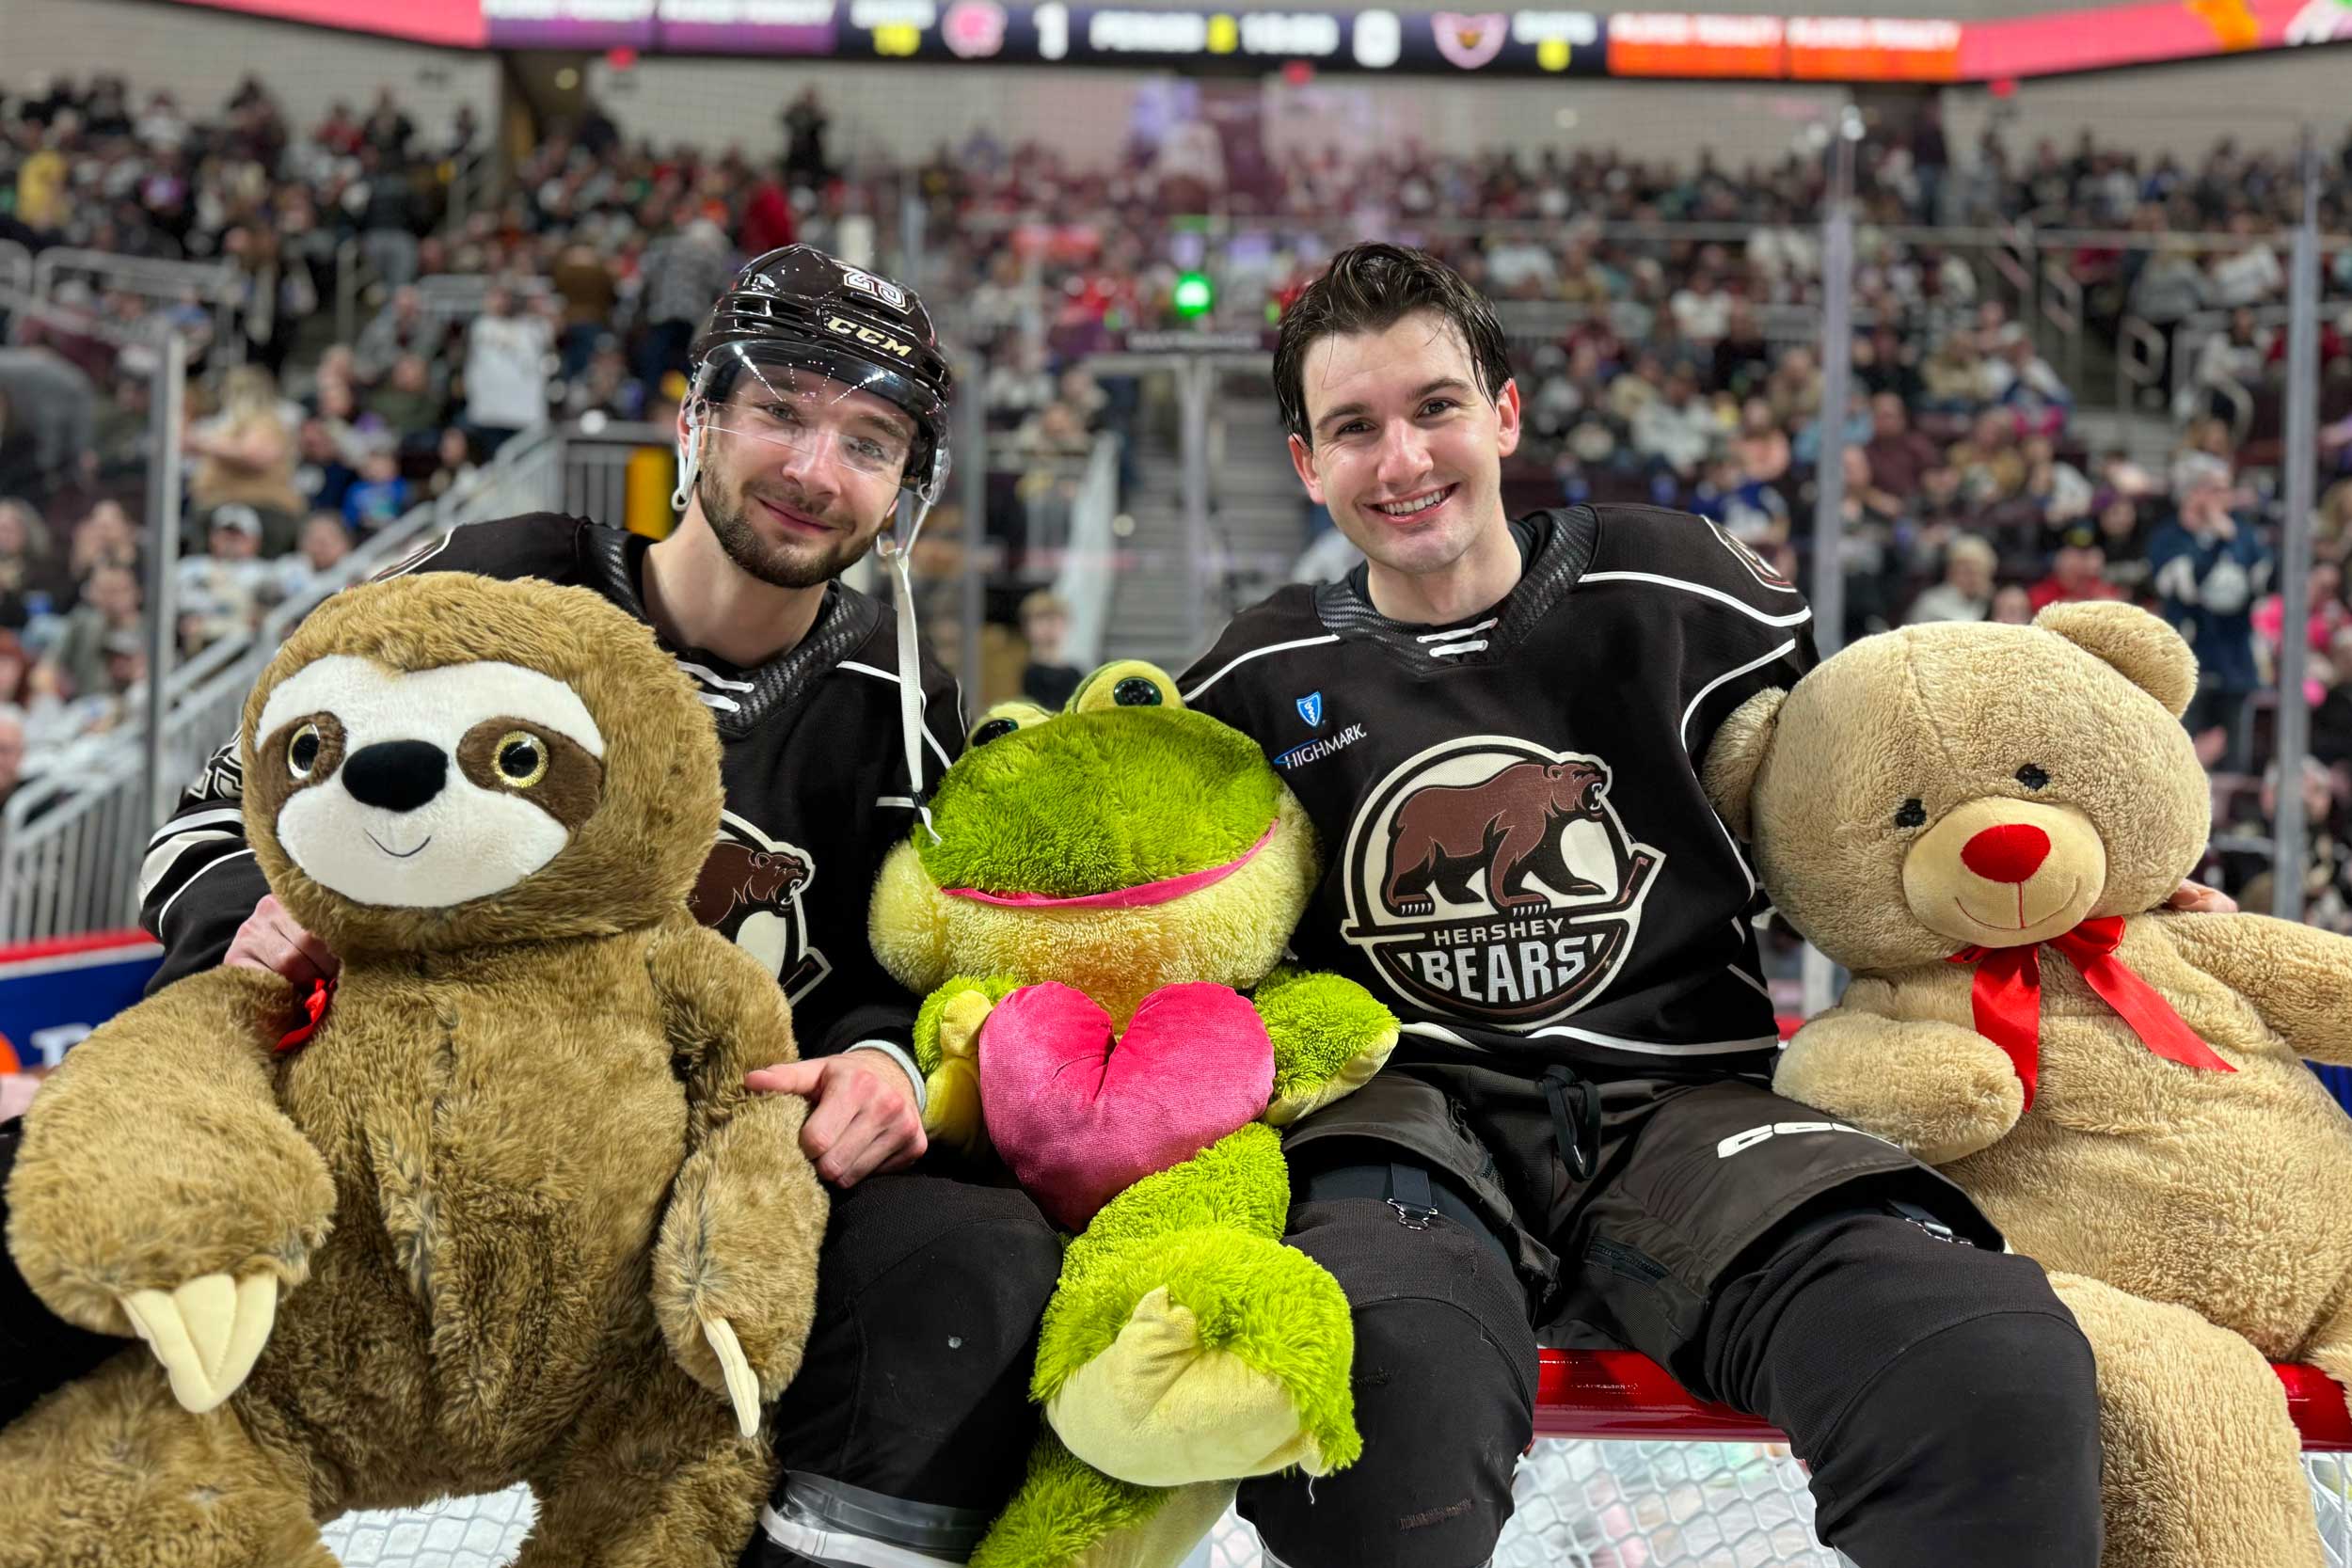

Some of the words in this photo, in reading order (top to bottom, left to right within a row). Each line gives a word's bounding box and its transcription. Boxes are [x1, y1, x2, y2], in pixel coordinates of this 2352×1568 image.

[828, 316, 913, 357] CCM
[1284, 722, 1365, 769] HIGHMARK
[1433, 917, 1564, 946] HERSHEY
[1417, 936, 1587, 1003] BEARS
